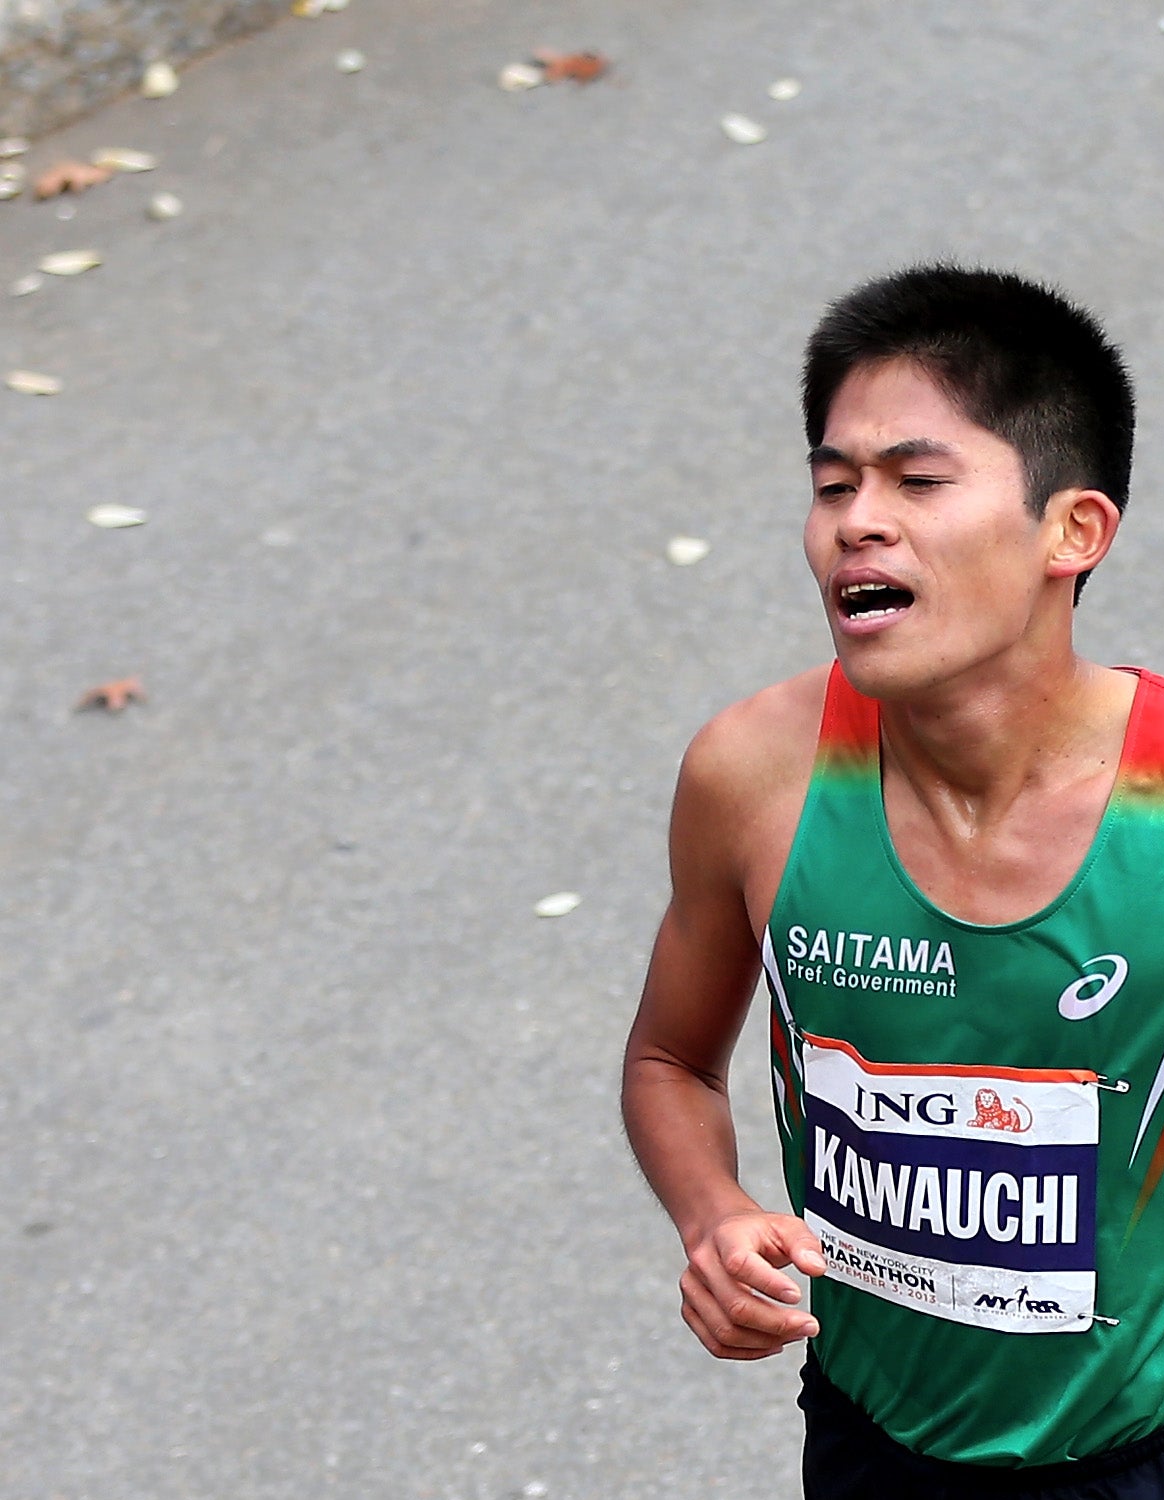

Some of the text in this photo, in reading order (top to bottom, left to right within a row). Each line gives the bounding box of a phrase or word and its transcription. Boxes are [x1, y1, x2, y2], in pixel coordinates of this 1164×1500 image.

[787, 925, 956, 976] SAITAMA
[787, 958, 957, 997] Pref. Government
[855, 1082, 958, 1125] ING
[813, 1125, 1078, 1245] KAWAUCHI
[820, 1229, 935, 1276] THE ING NEW YORK CITY
[820, 1239, 936, 1293] MARATHON
[908, 1288, 937, 1304] 2013
